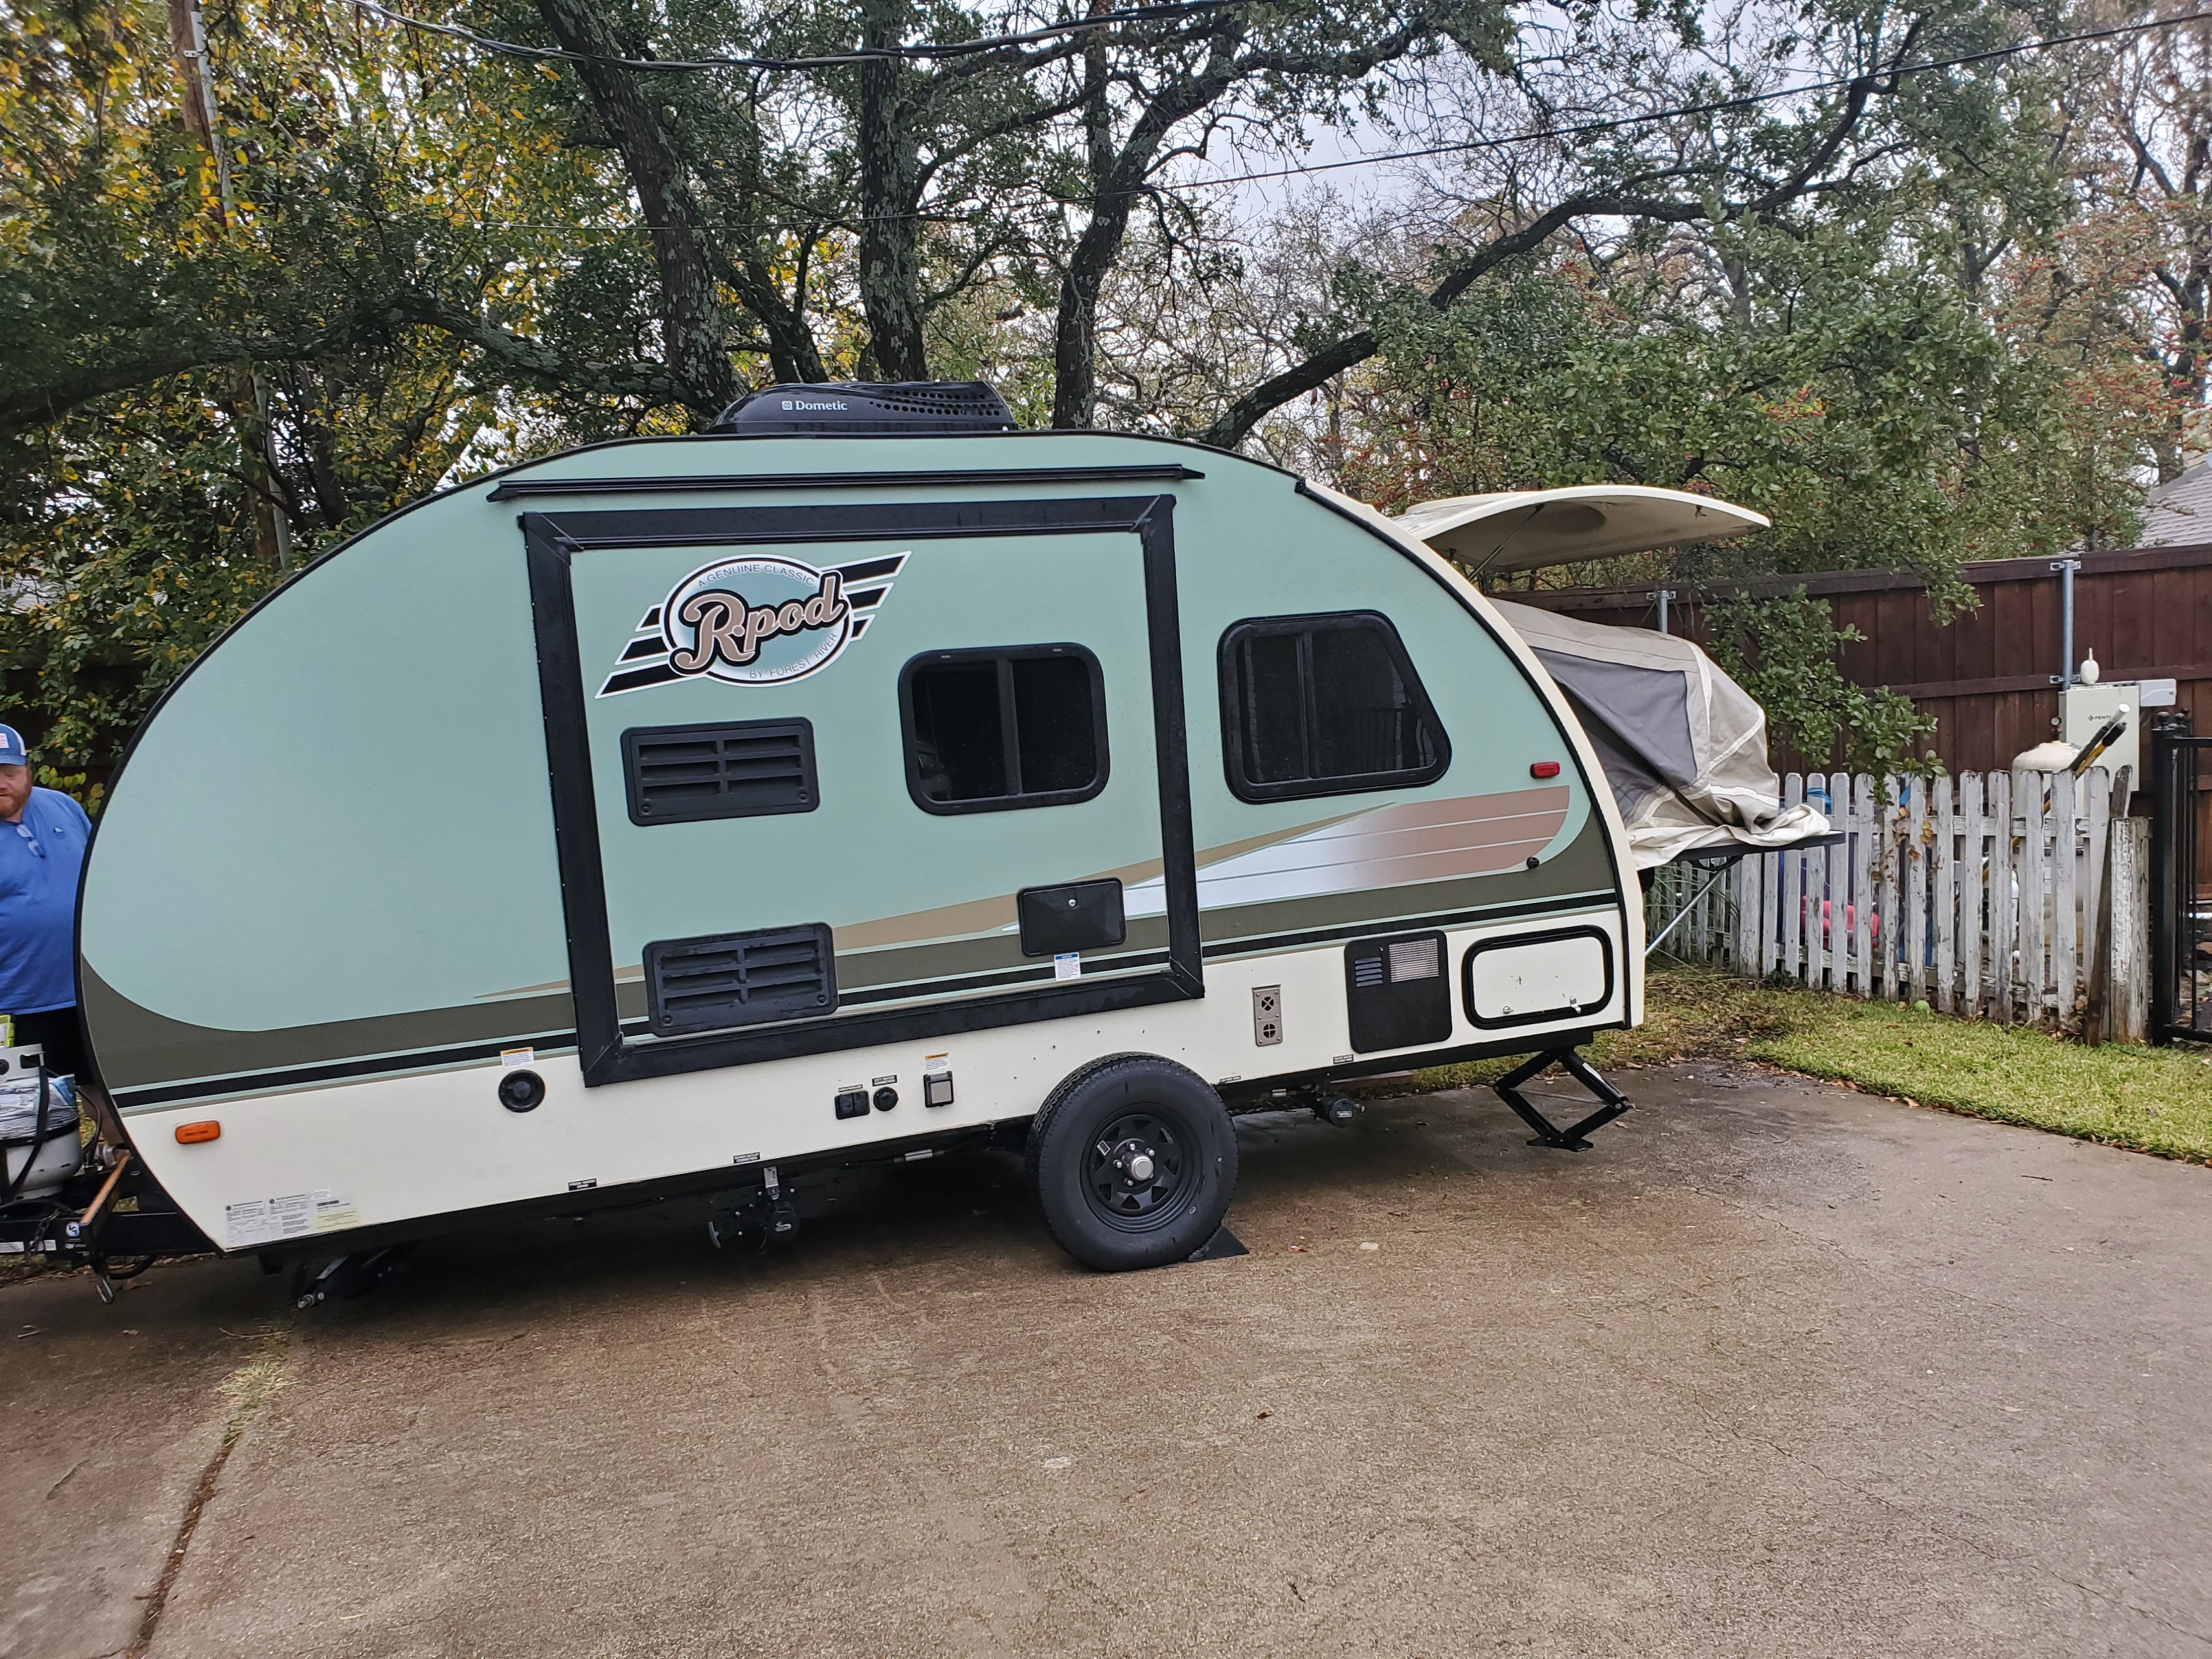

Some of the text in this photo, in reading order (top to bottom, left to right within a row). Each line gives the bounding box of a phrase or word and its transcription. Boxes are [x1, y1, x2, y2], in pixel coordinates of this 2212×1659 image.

[795, 400, 848, 410] Dometic
[698, 564, 815, 588] A GENUINE CLASSIC
[749, 633, 838, 679] BY FOREST RIVER
